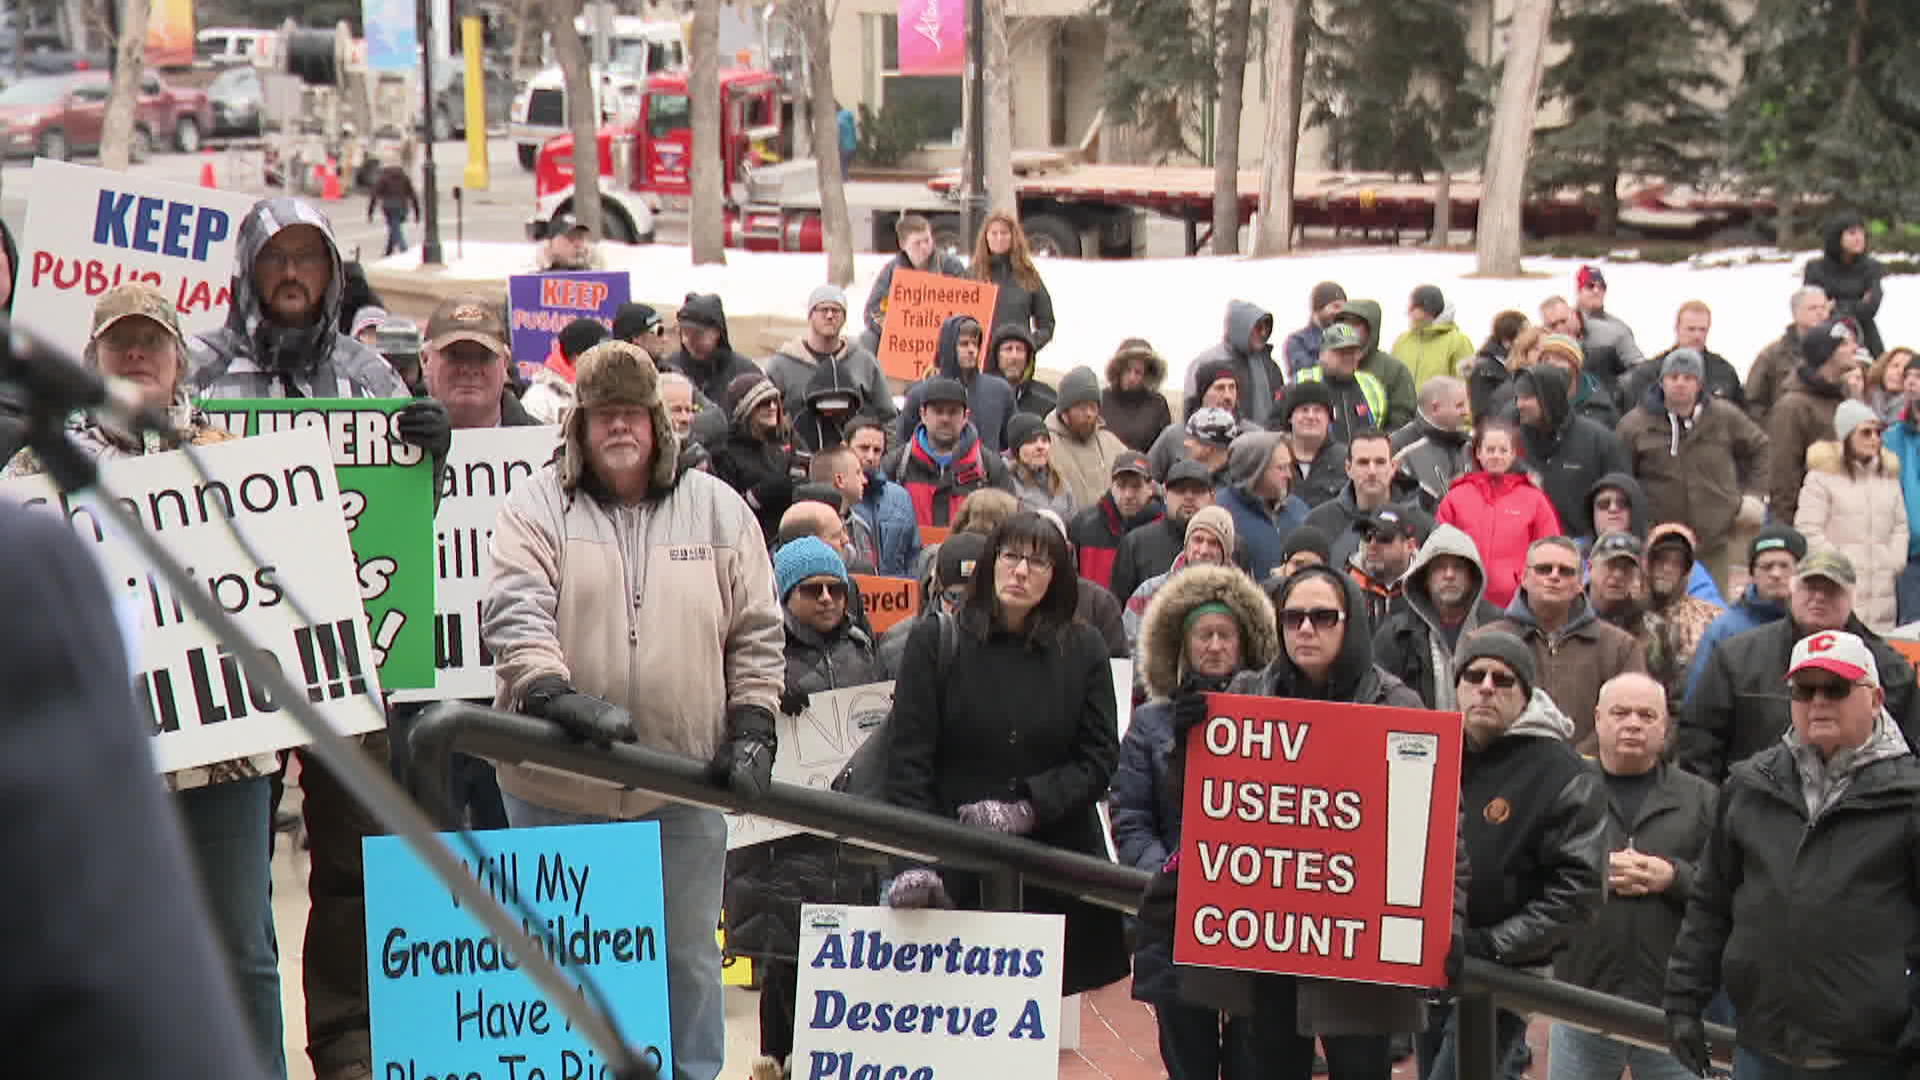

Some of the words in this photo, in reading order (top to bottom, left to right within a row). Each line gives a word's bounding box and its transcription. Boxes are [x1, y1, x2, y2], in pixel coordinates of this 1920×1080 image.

[93, 188, 230, 263] KEEP
[542, 278, 608, 310] KEEP
[894, 285, 981, 306] Engineered
[901, 309, 941, 328] Trails
[22, 465, 325, 543] hnnon
[1205, 716, 1310, 762] OHV
[1202, 777, 1362, 831] USERS
[535, 851, 590, 917] My
[1197, 840, 1356, 894] VOTES
[811, 929, 1045, 978] Albertans
[1193, 905, 1366, 960] COUNT
[455, 988, 550, 1042] Have
[809, 989, 998, 1038] Deserve
[1008, 999, 1046, 1040] A
